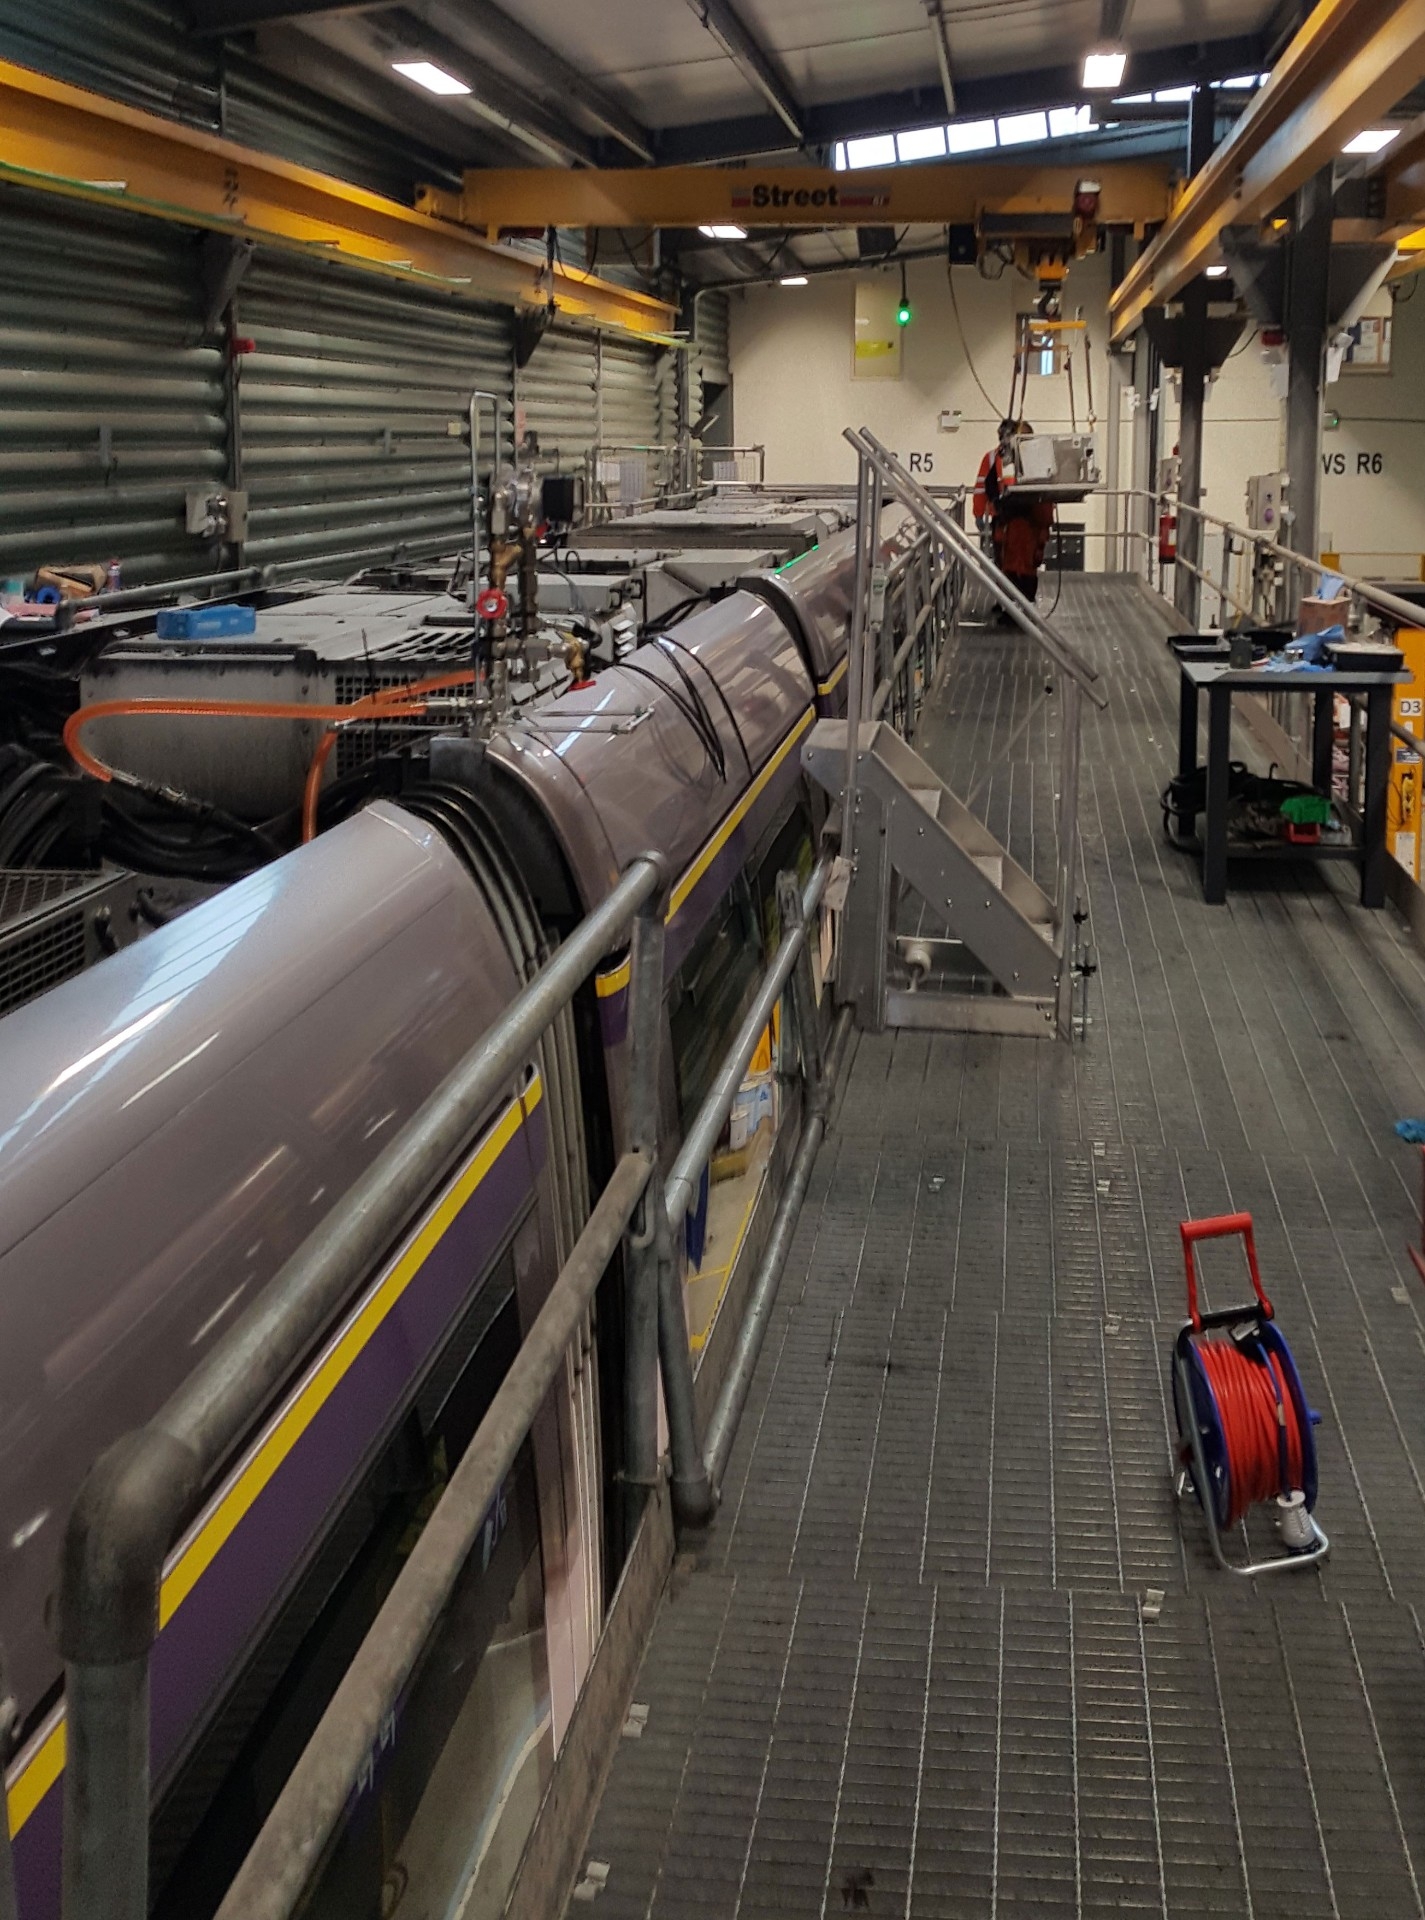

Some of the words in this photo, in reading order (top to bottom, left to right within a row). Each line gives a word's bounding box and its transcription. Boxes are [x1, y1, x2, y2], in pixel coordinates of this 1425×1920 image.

[752, 184, 838, 208] Street
[910, 452, 933, 472] R5
[1322, 453, 1345, 474] VS
[1357, 453, 1382, 474] R6
[1401, 701, 1421, 713] D3
